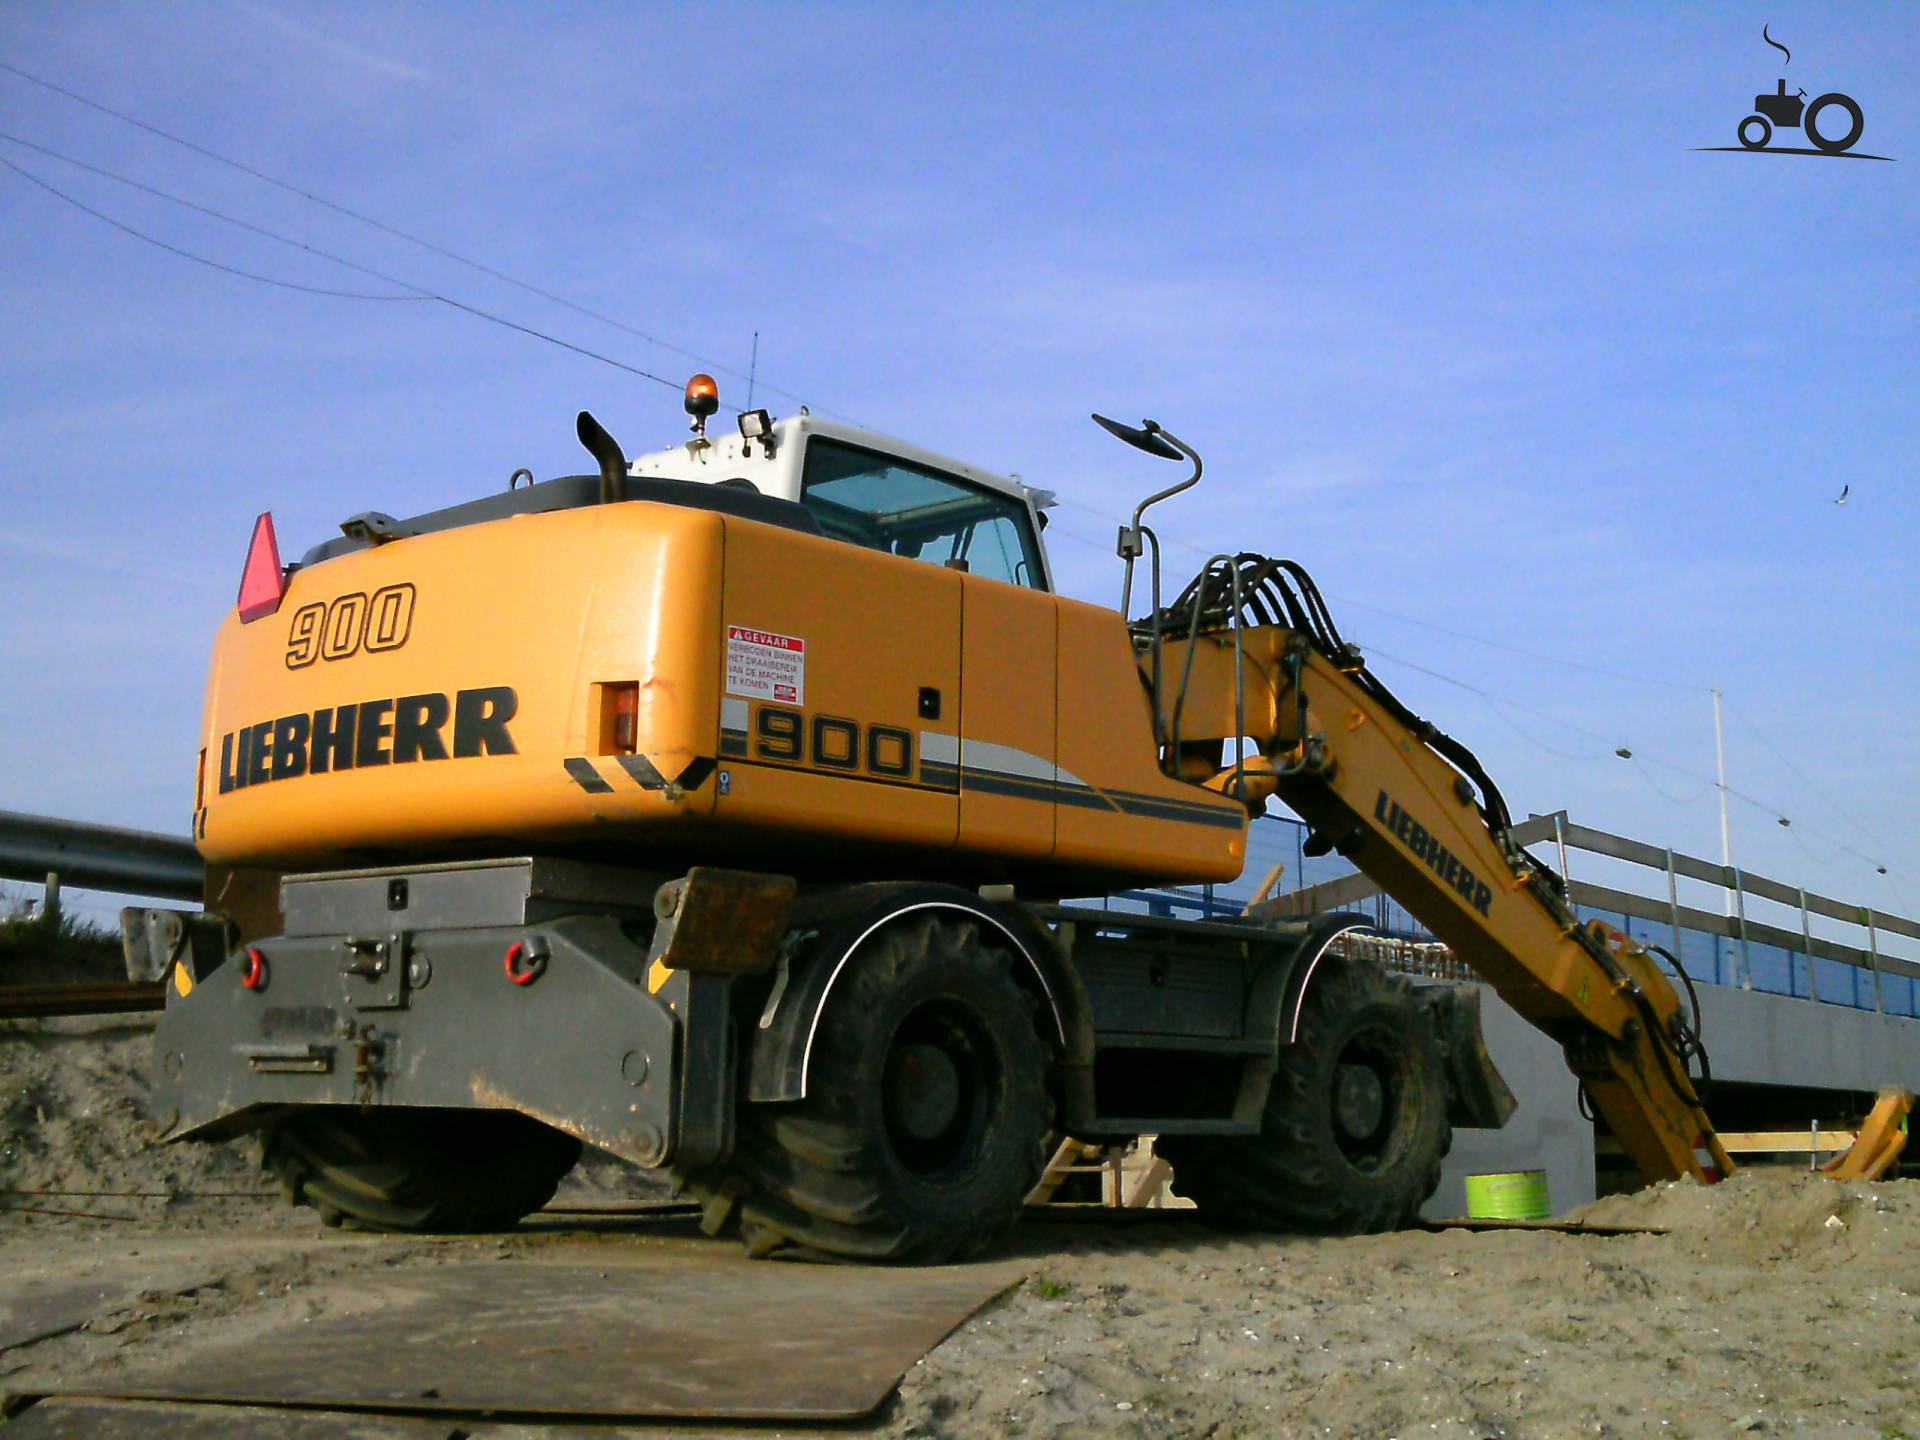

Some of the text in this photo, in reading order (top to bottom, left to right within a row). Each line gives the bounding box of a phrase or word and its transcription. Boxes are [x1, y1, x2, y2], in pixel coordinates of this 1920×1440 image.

[284, 581, 416, 670] 900
[744, 631, 788, 648] GEVAAR
[728, 655, 744, 663] HET
[728, 665, 795, 684] VAN DE MACHINE
[728, 675, 769, 690] TE KOMEN
[219, 685, 519, 794] LIEBHERR
[755, 705, 914, 780] 900
[1373, 789, 1493, 919] LIEBHERR
